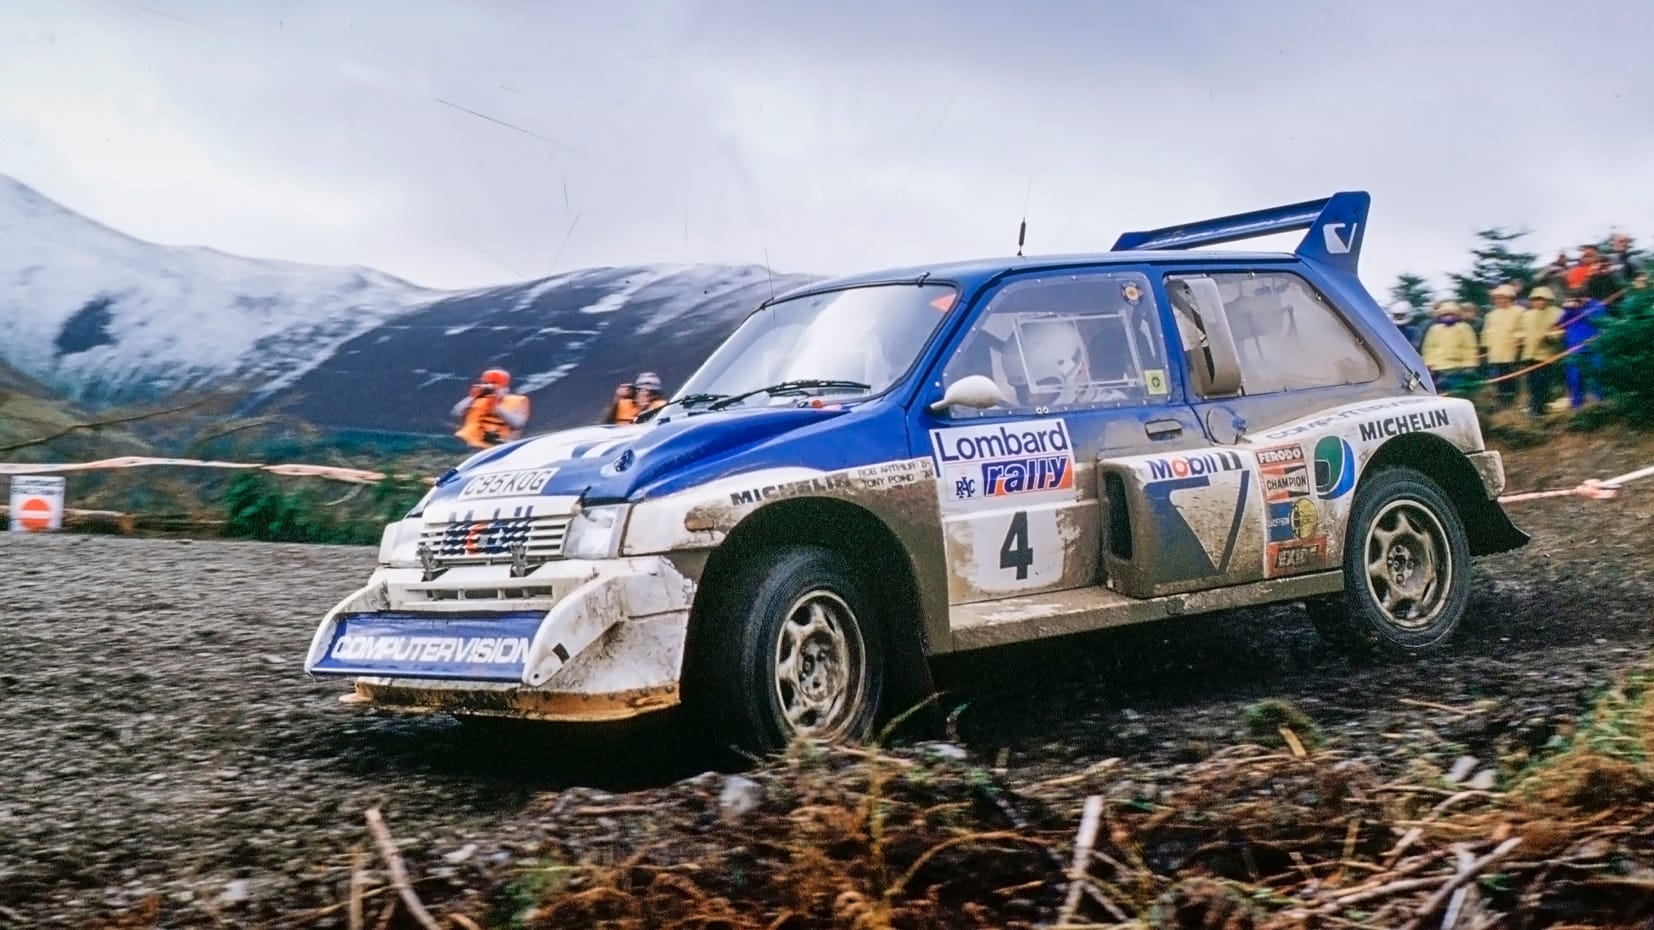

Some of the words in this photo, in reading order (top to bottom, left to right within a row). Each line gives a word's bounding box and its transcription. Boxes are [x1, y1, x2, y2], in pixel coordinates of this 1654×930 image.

[934, 421, 1069, 462] Lombard
[1358, 408, 1450, 442] MICHELIN
[1144, 454, 1218, 480] Mobil
[1257, 447, 1302, 464] FERODO
[729, 471, 852, 506] MICHELIN
[985, 456, 1068, 496] rally
[1266, 475, 1307, 490] CHAMPION
[1000, 510, 1034, 580] 4
[330, 635, 531, 665] COMPUTERVISION
